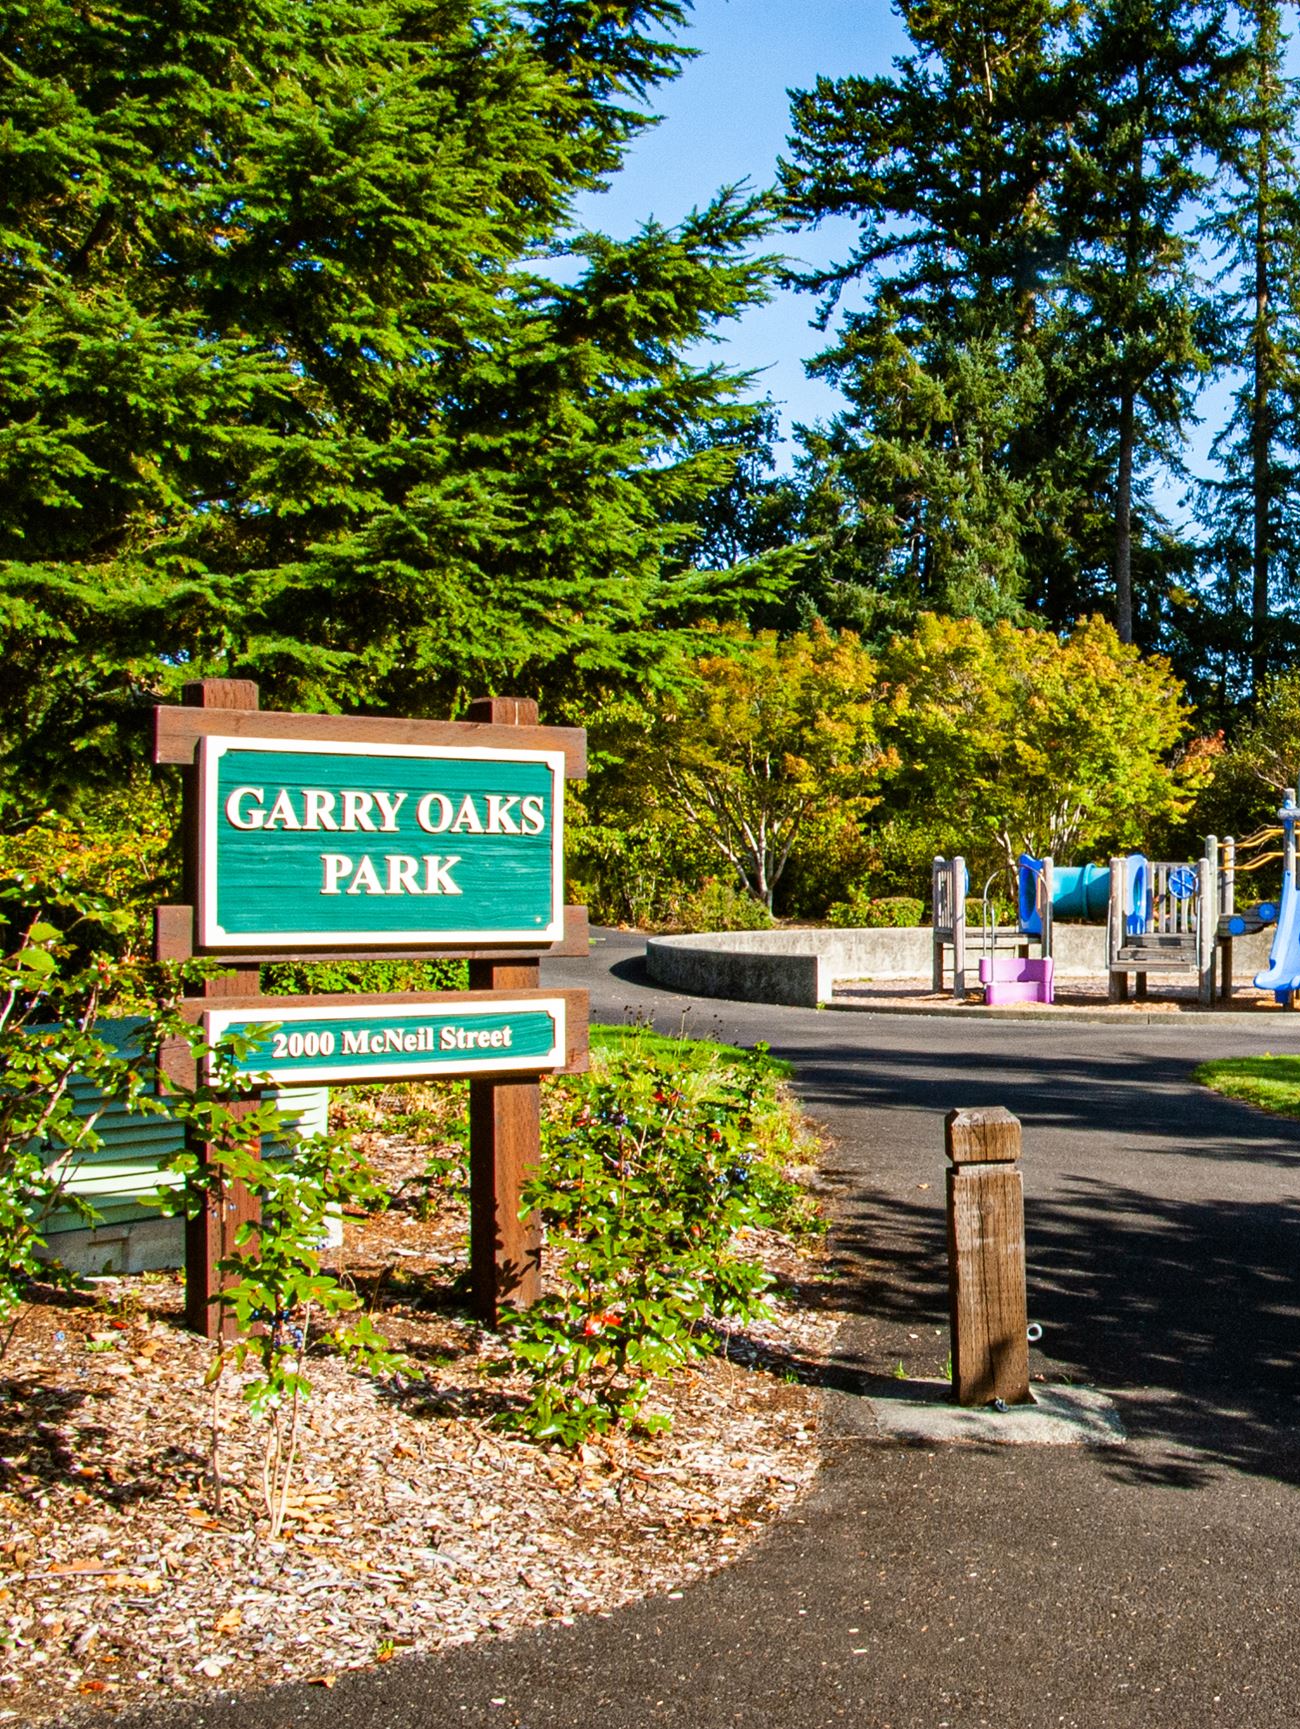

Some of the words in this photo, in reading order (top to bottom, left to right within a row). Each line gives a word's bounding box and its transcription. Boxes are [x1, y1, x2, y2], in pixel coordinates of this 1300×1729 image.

[226, 786, 407, 832] GARRY
[416, 794, 545, 835] OAKS
[320, 855, 462, 896] PARK
[272, 1031, 335, 1058] 2000
[342, 1027, 434, 1055] McNeil
[439, 1025, 512, 1050] Street
